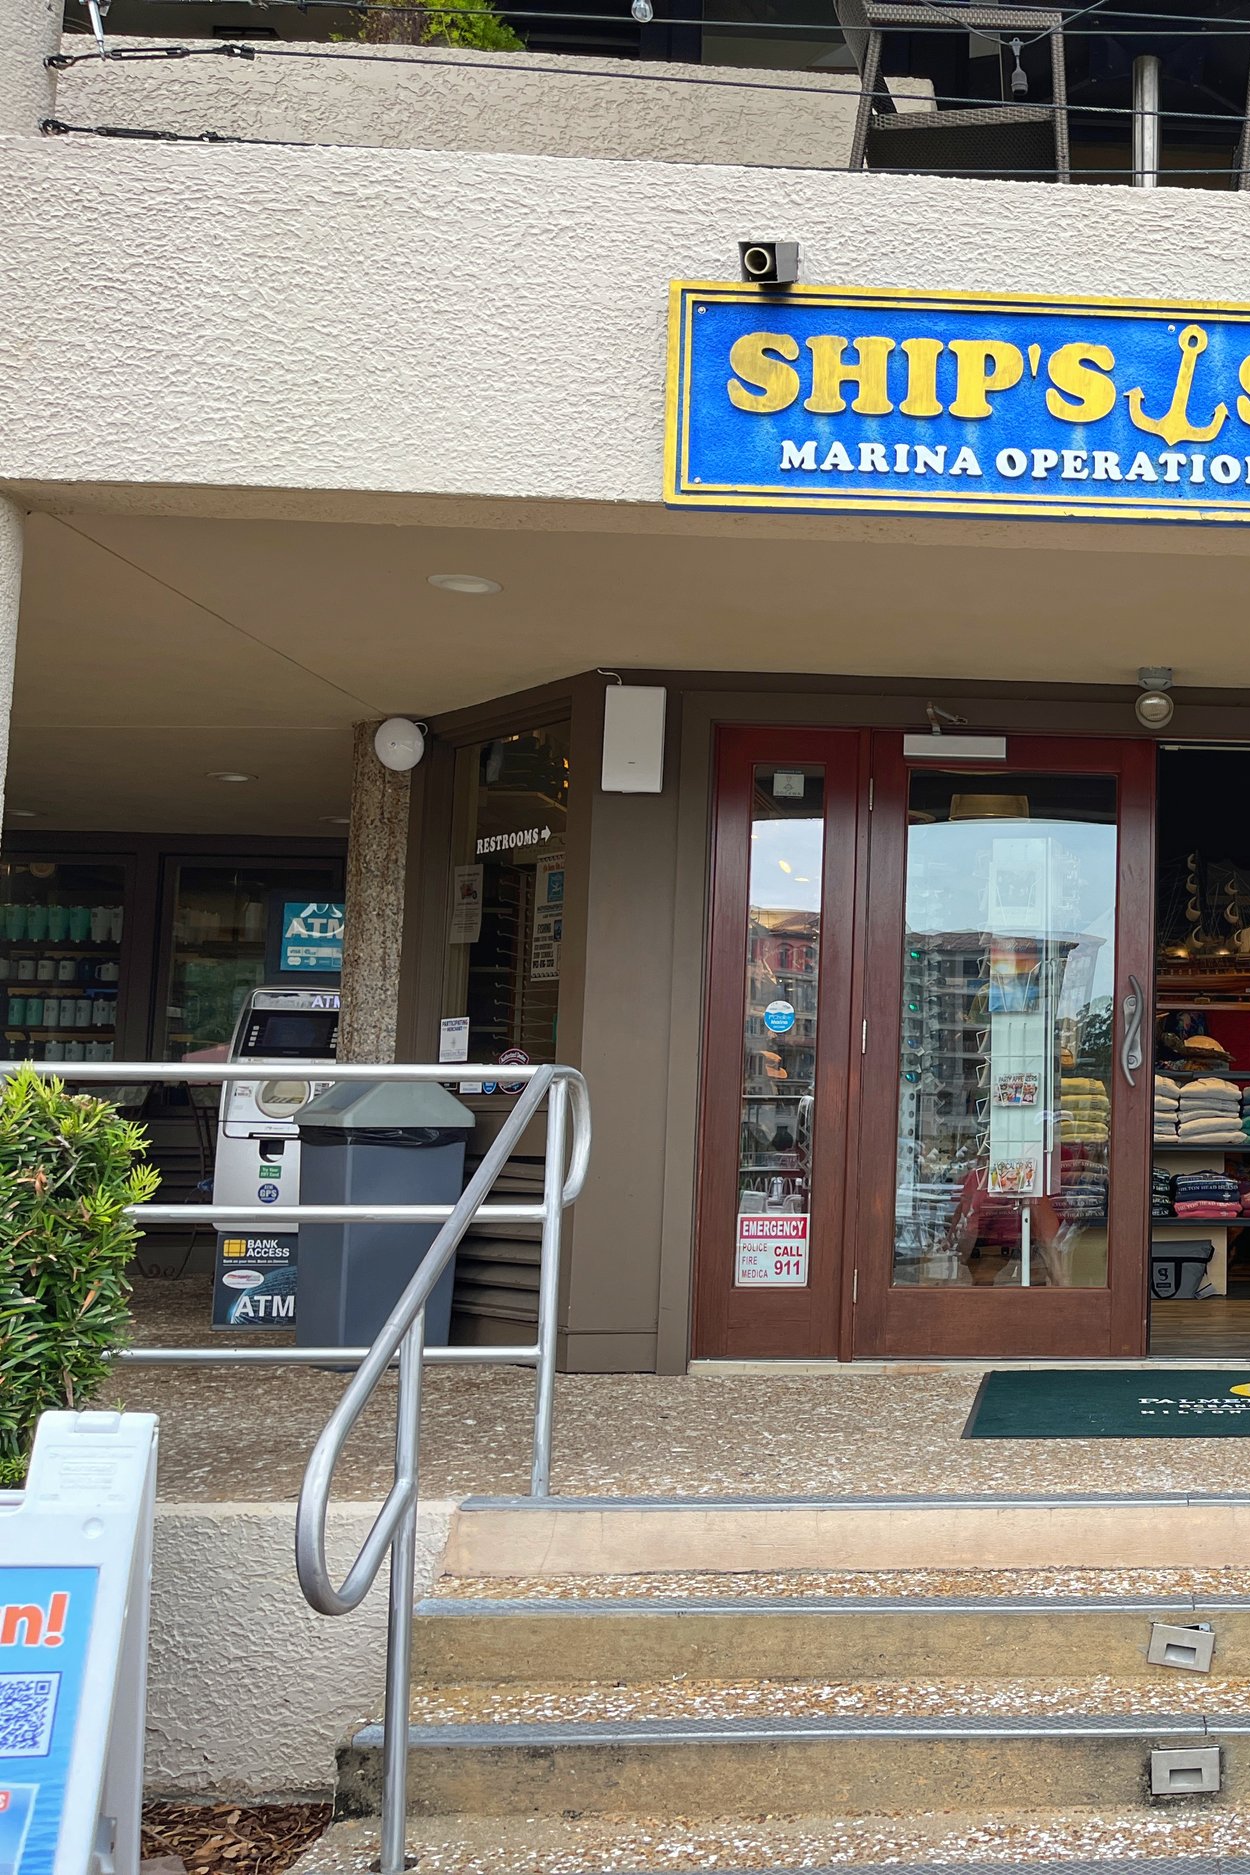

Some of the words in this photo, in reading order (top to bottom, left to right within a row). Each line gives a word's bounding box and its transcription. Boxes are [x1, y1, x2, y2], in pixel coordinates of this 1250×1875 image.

[727, 332, 1116, 423] SHIP'S
[780, 440, 983, 477] MARINA
[476, 828, 539, 855] RESTROOMS
[259, 1189, 277, 1198] GPS
[743, 1220, 804, 1236] EMERGENCY
[247, 1239, 278, 1249] BANK
[743, 1242, 768, 1252] POLICE
[246, 1248, 290, 1257] ACCESS
[774, 1246, 803, 1257] CALL
[742, 1256, 757, 1265] FIRE
[742, 1269, 768, 1279] MEDICA
[774, 1260, 800, 1275] 911
[235, 1295, 295, 1317] ATM
[0, 1591, 70, 1647] n!
